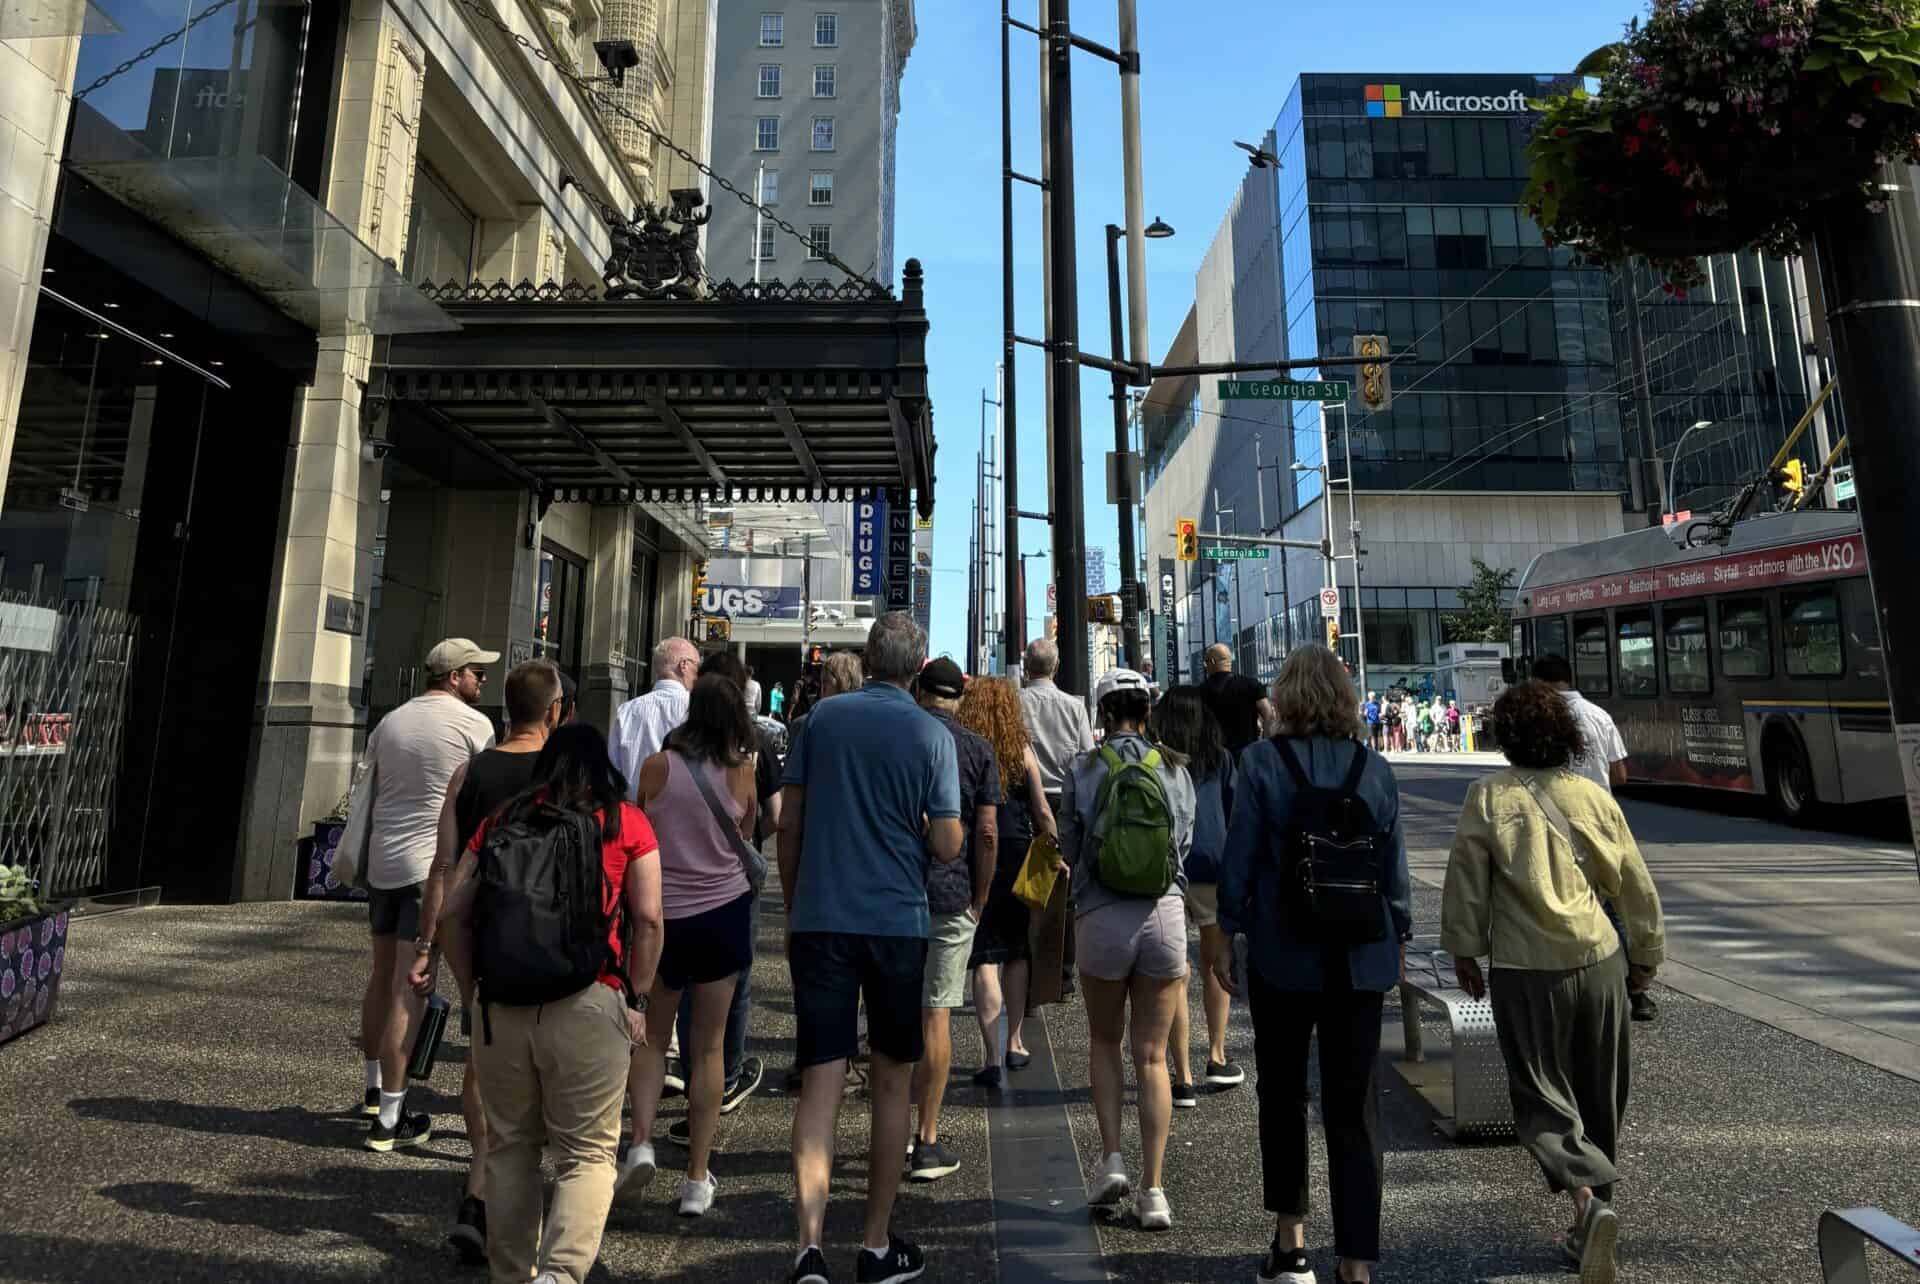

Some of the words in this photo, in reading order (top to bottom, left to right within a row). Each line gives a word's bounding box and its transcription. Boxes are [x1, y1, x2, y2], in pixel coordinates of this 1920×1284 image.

[1409, 89, 1528, 112] Microsoft
[1227, 383, 1240, 396] W
[1250, 382, 1315, 399] Georgia
[1325, 383, 1340, 397] St
[858, 504, 873, 588] DRUGS
[1217, 548, 1253, 559] Georgia
[1668, 574, 1680, 588] The
[1748, 560, 1763, 576] and
[1763, 560, 1785, 575] more
[1785, 553, 1804, 572] with
[1804, 551, 1819, 569] the
[1821, 541, 1855, 571] VSO
